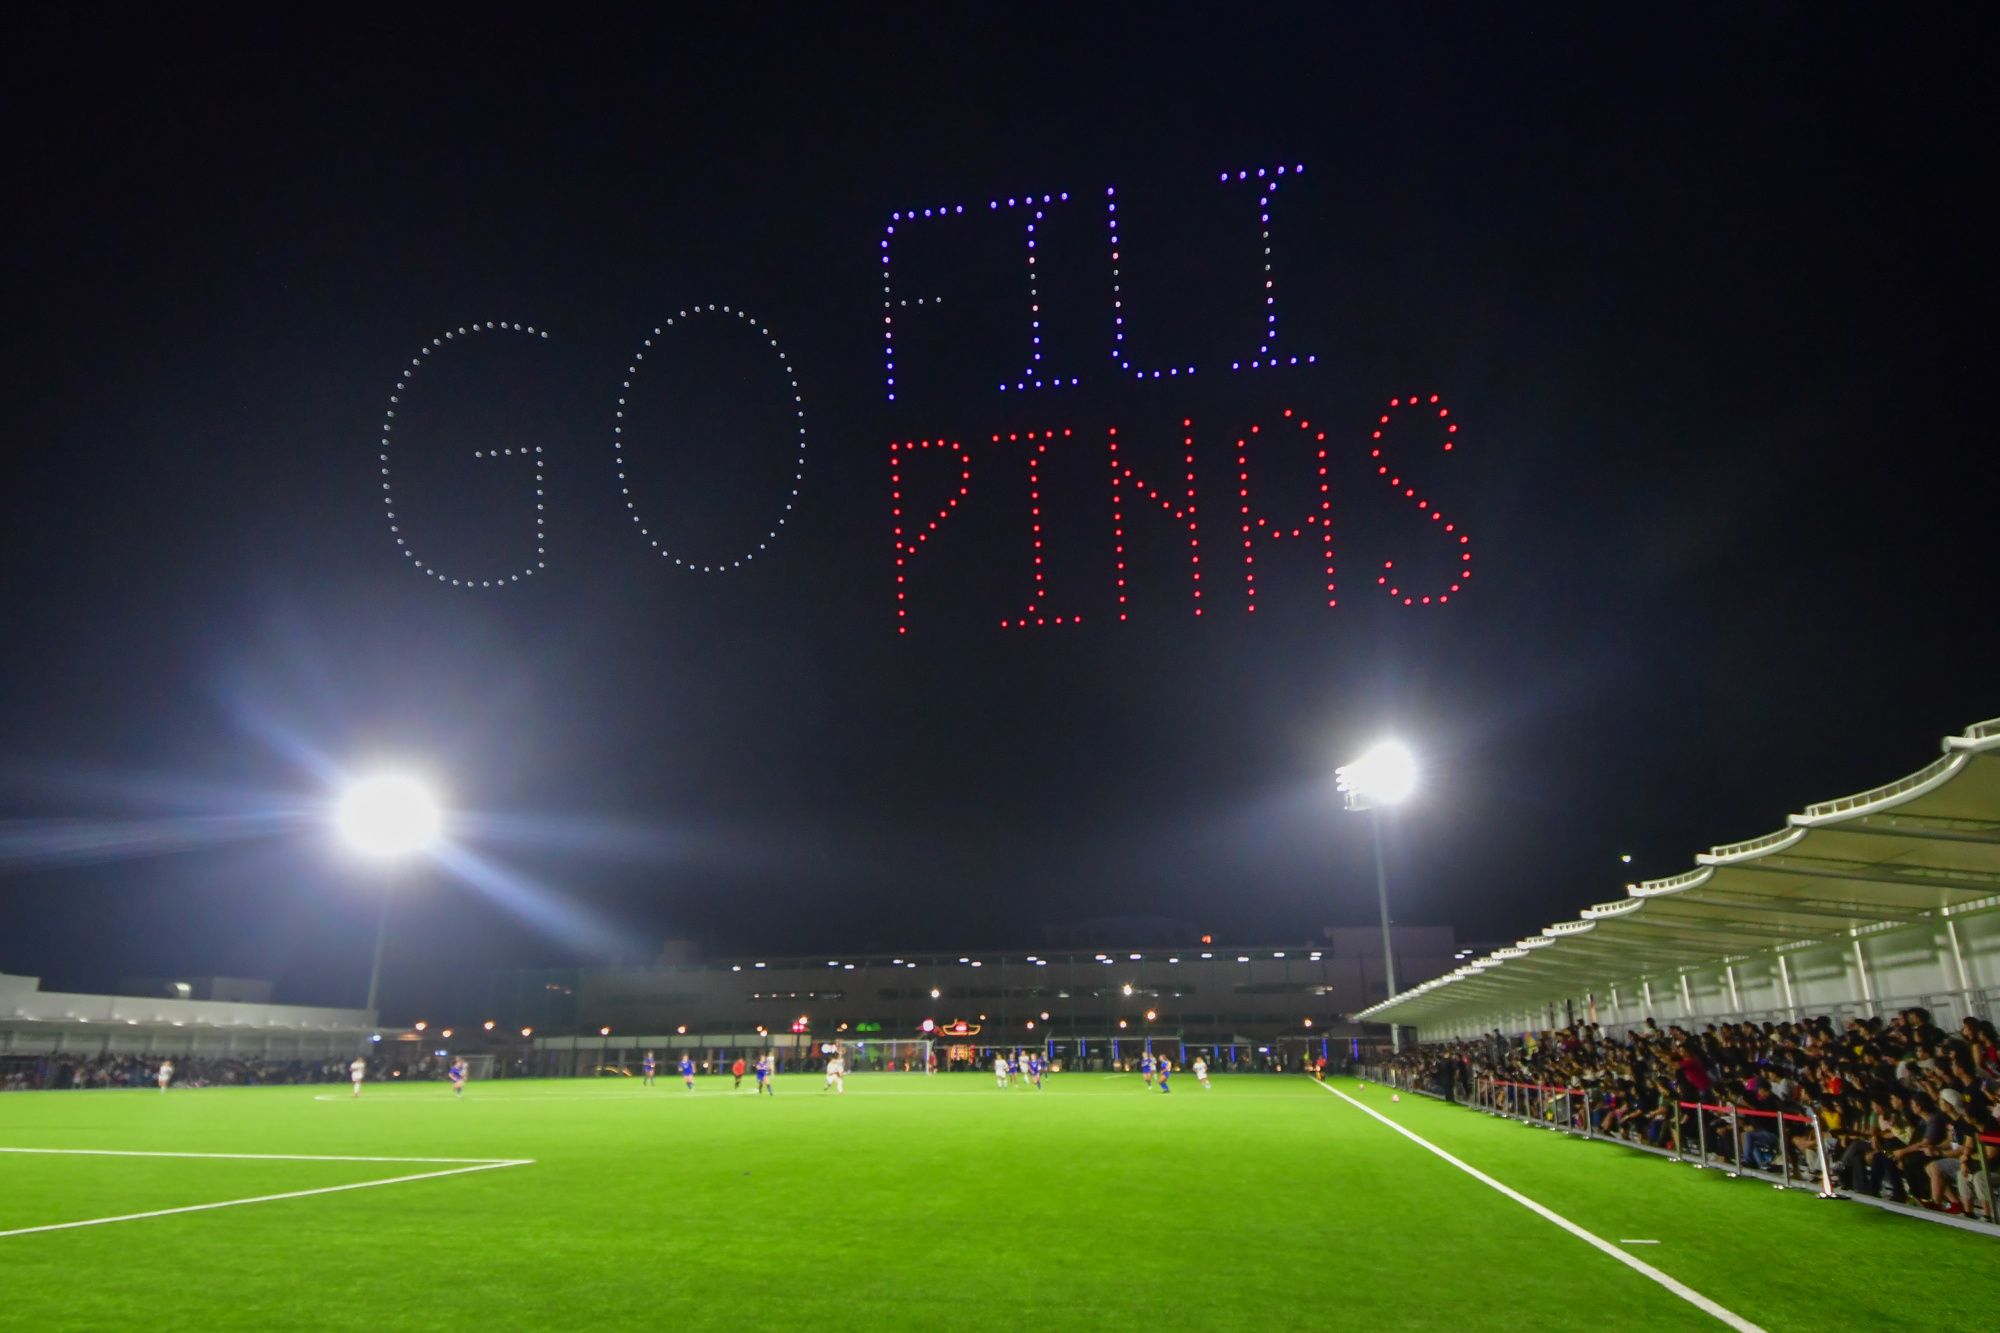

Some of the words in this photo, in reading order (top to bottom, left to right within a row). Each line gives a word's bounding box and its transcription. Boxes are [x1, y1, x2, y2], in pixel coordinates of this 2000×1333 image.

[879, 163, 1317, 402] FILI
[379, 302, 806, 589] GO
[886, 393, 1472, 635] PINAS
